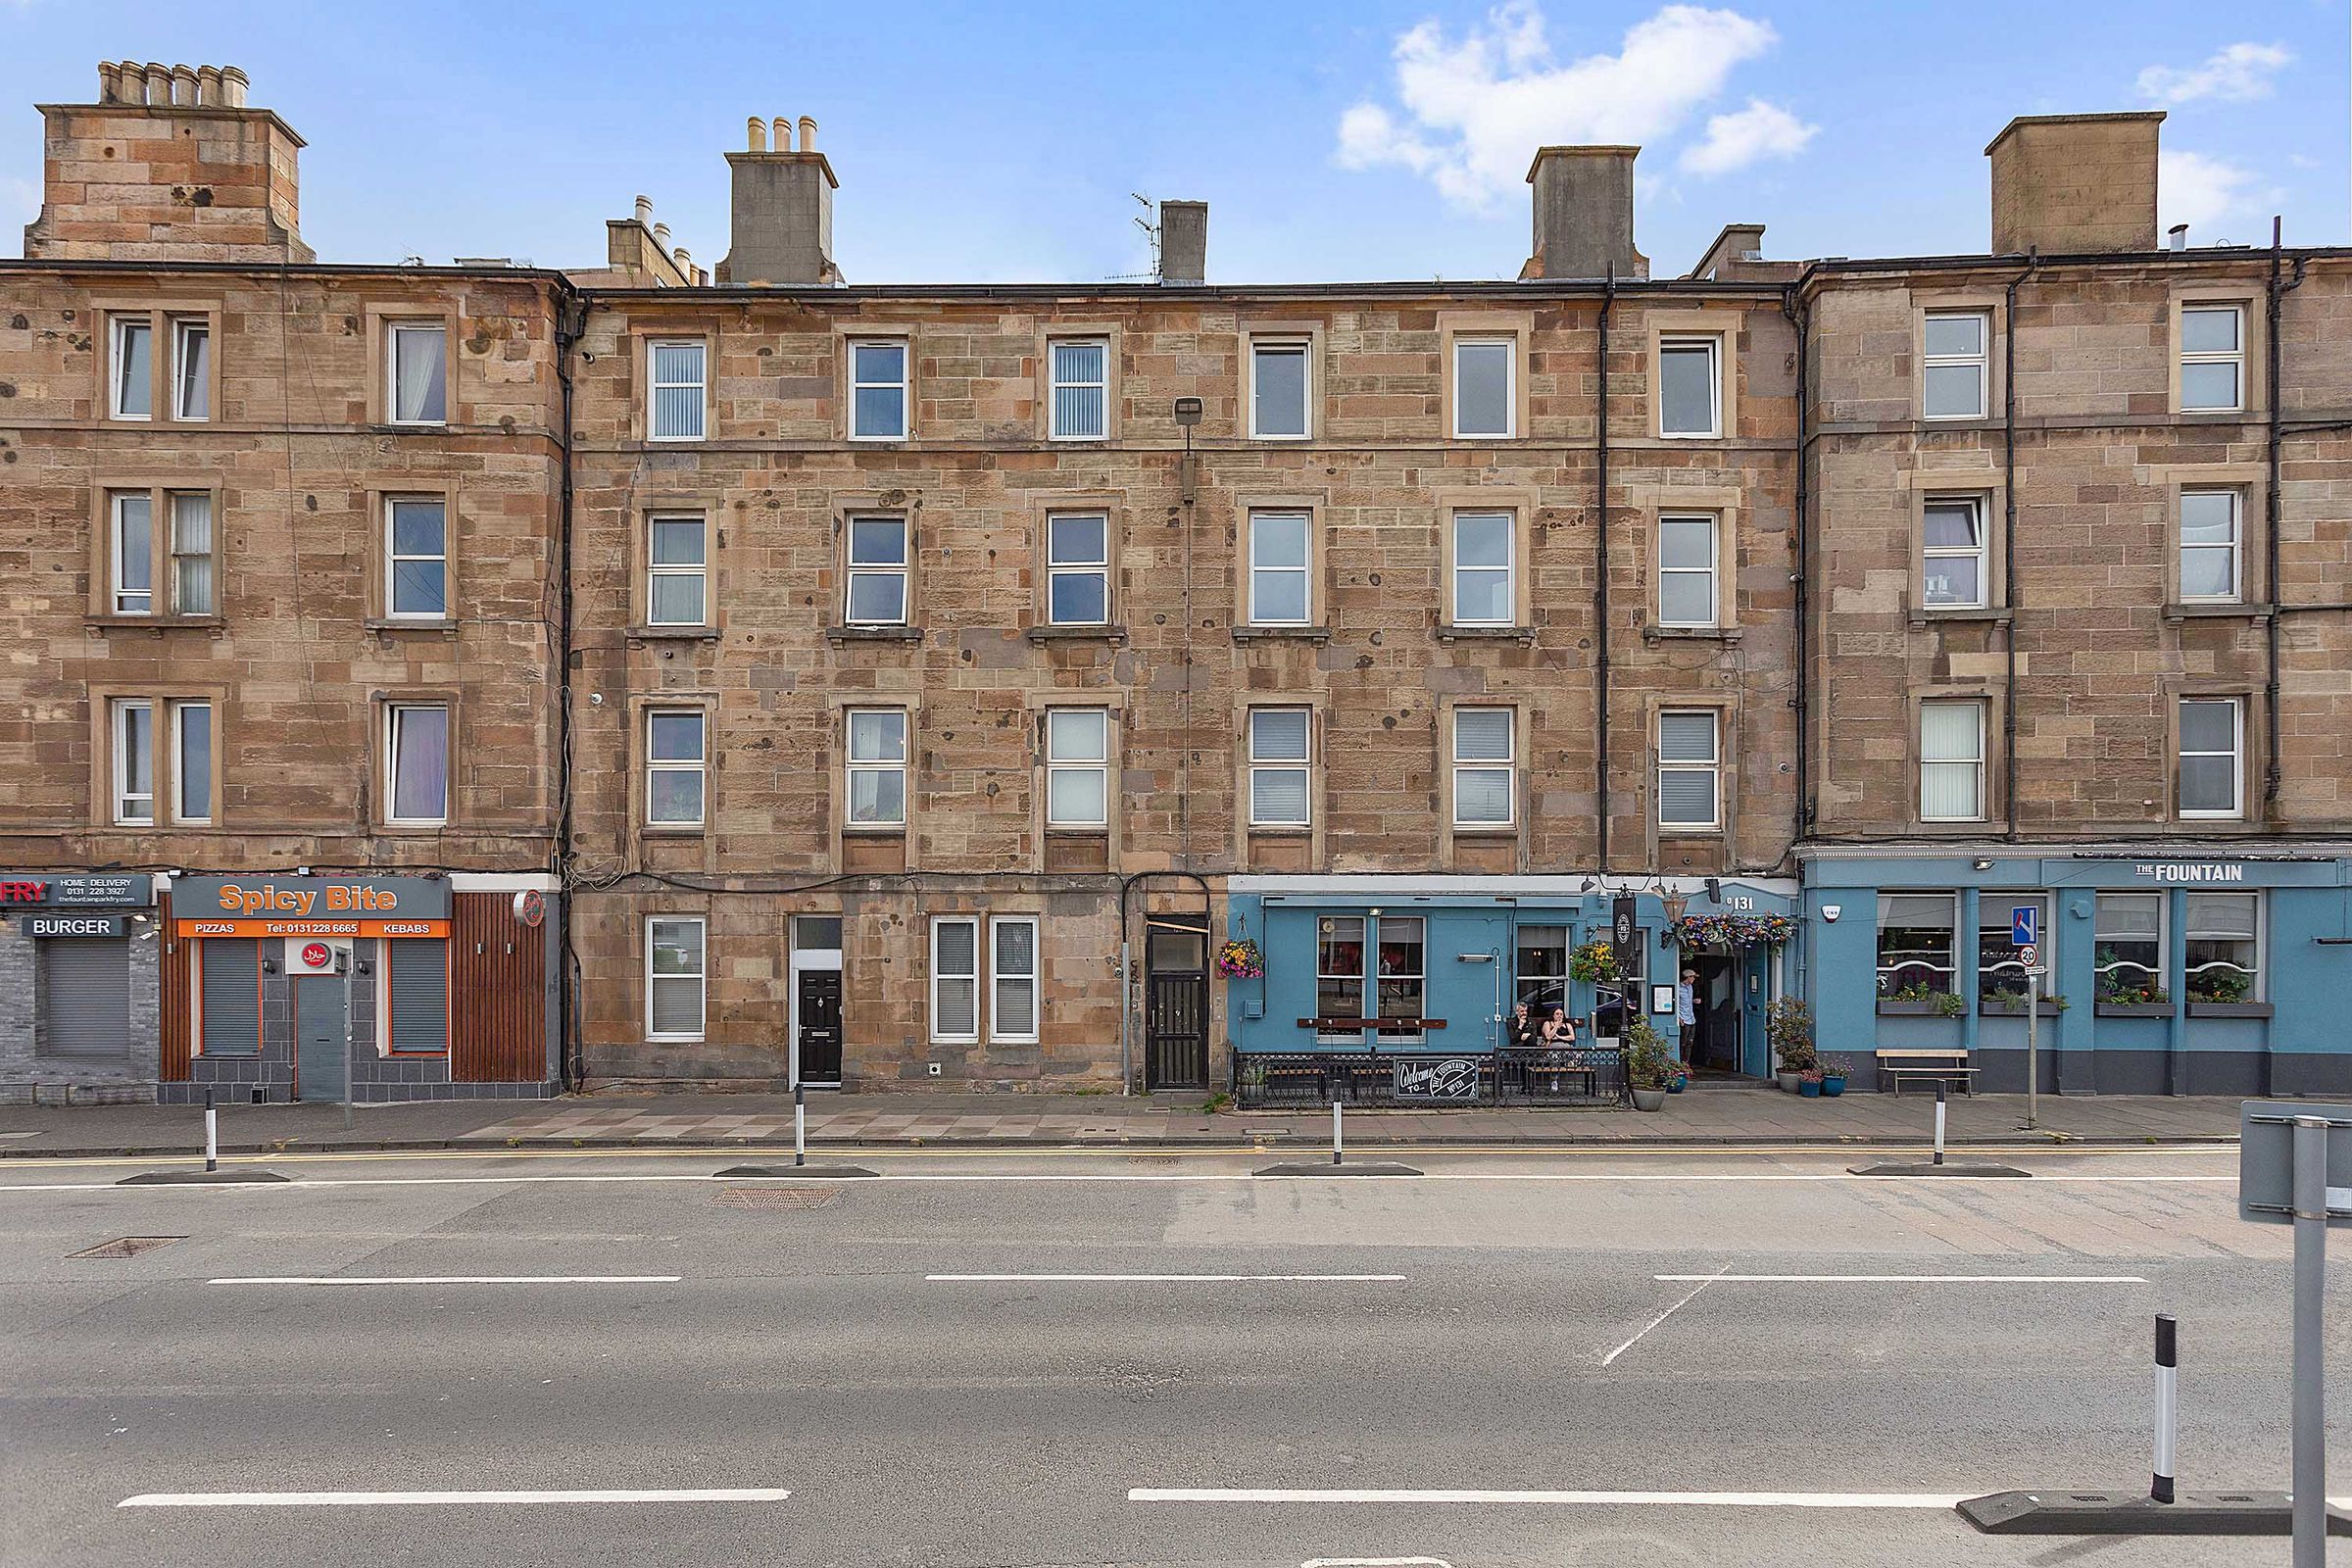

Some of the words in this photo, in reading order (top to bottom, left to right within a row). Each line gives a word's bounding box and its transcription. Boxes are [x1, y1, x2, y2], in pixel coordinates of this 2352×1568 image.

[2135, 864, 2154, 873] THE
[2156, 864, 2242, 881] FOUNTAIN
[0, 881, 46, 903] FRY
[219, 885, 318, 916] Spicy
[325, 885, 397, 910] Bite
[33, 919, 111, 934] BURGER
[195, 923, 234, 933] PIZZAS
[267, 923, 285, 933] Tel:
[287, 923, 313, 933] 0131
[314, 923, 331, 933] 228
[333, 923, 358, 933] 6665
[383, 923, 430, 934] KEBABS
[2022, 951, 2034, 960] 20
[1398, 1062, 1434, 1088] Welcome
[1438, 1062, 1465, 1076] FOUNTAIN
